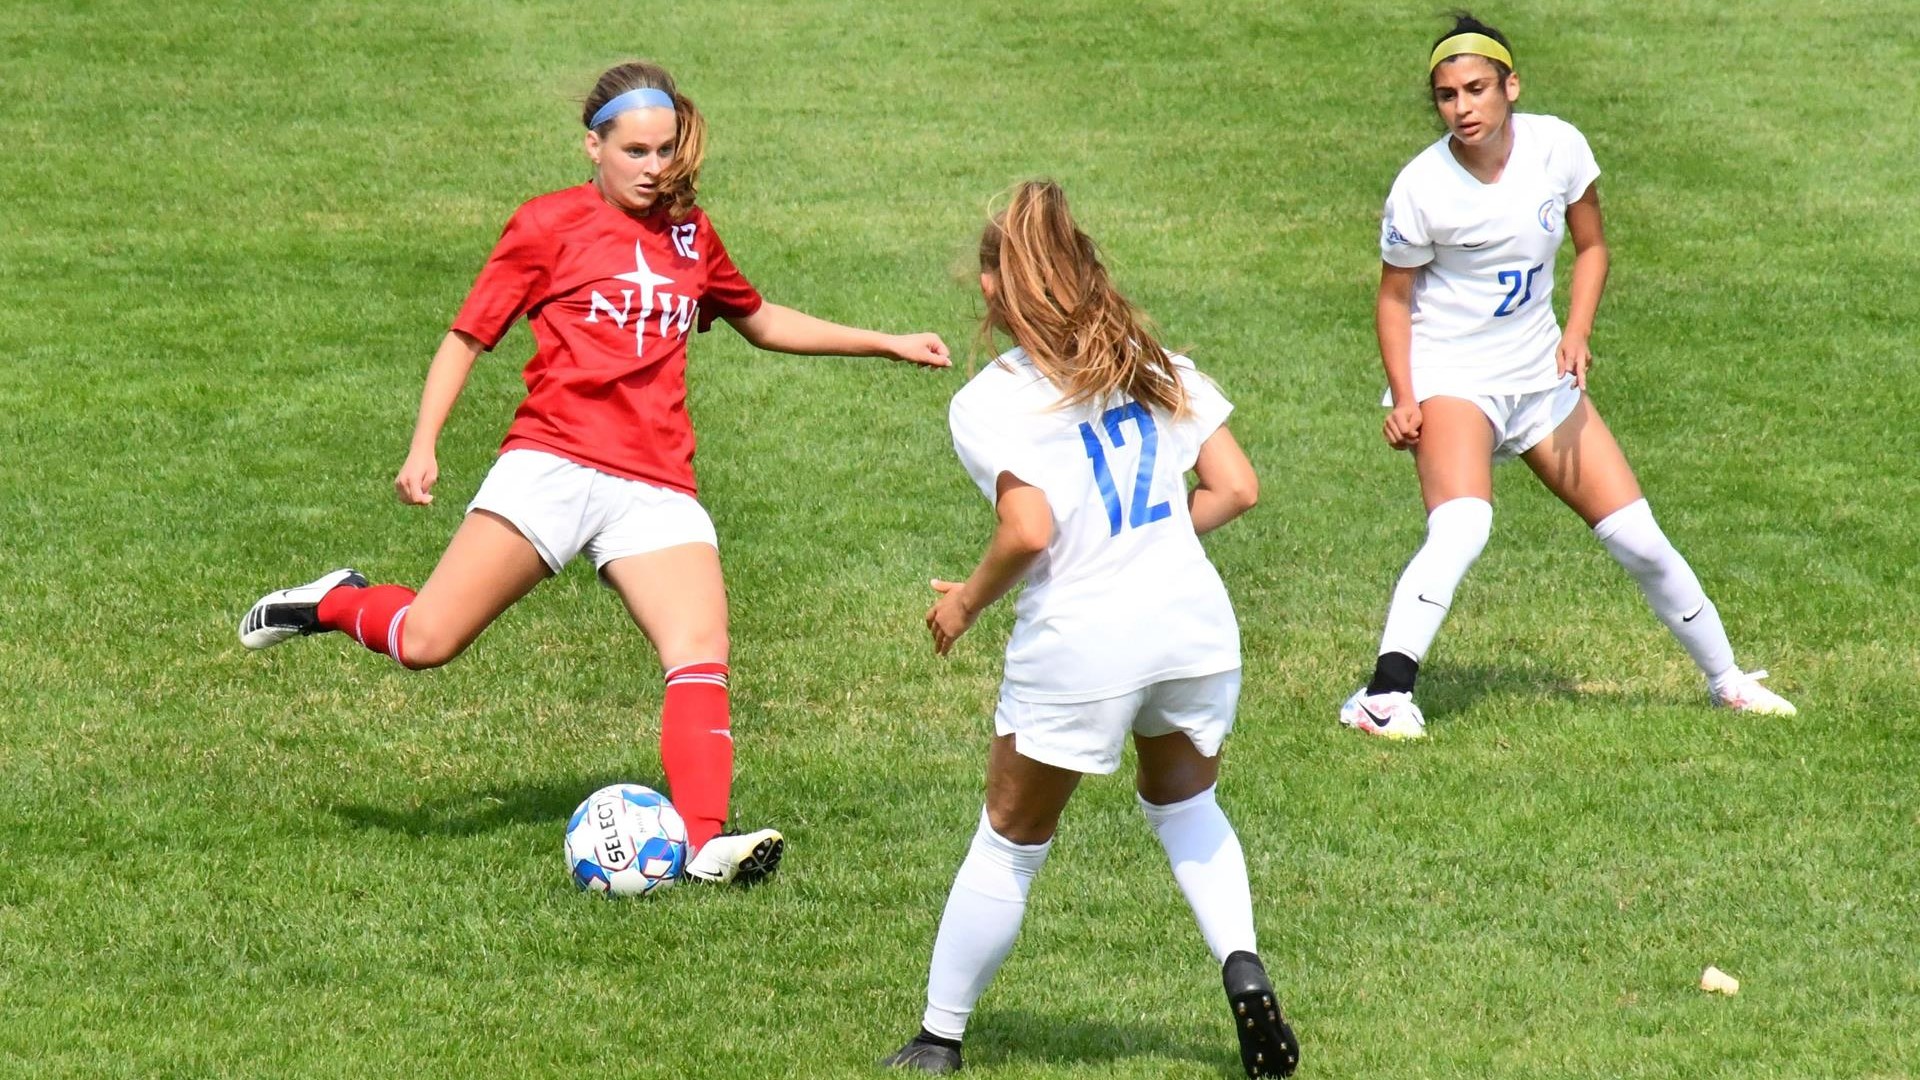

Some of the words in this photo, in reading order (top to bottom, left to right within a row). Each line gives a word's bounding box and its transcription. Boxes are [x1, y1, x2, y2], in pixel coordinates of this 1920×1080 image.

[671, 223, 700, 261] 12
[1078, 400, 1172, 538] 12
[597, 801, 626, 863] SELECT
